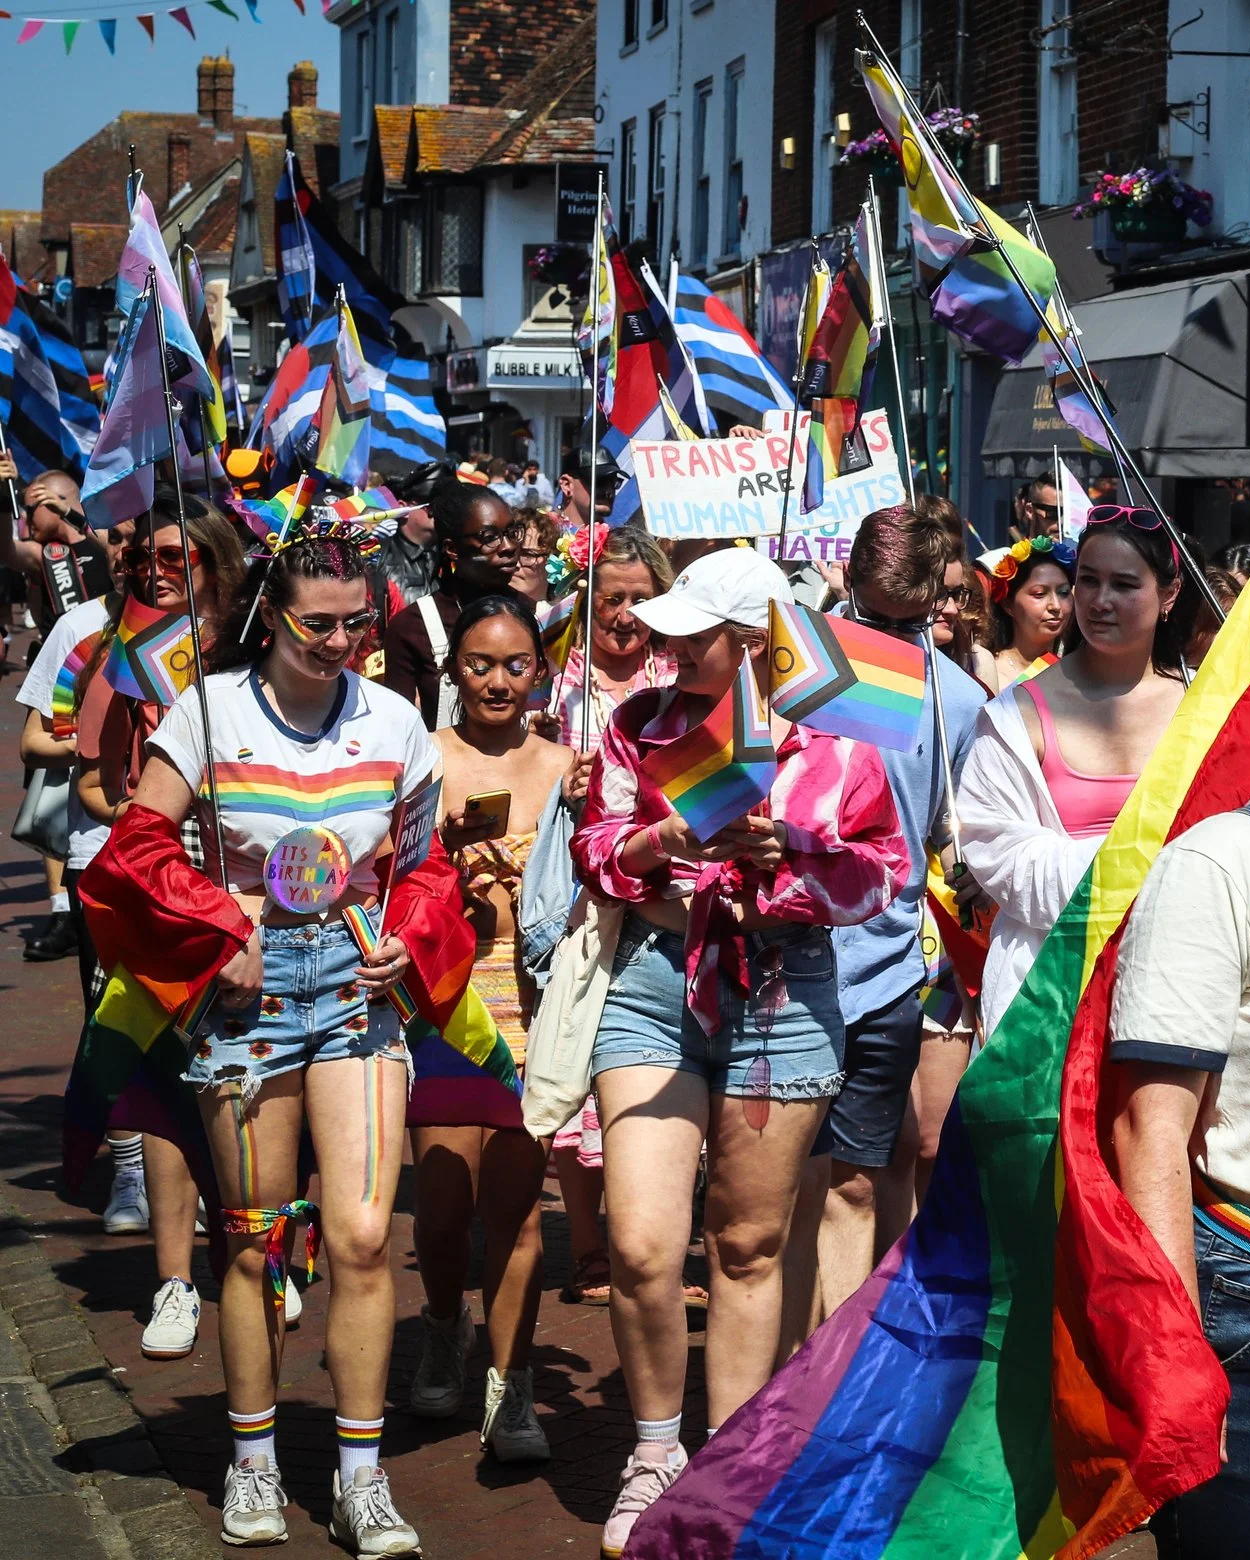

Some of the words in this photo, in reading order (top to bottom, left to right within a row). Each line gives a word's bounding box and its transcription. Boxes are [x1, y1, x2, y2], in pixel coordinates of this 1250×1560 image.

[568, 204, 595, 214] Hotel
[494, 362, 541, 377] BUBBLE
[545, 362, 572, 377] MILK
[635, 441, 757, 479] TRANS
[737, 468, 796, 499] ARE
[646, 500, 766, 537] HUMAN
[768, 534, 853, 561] HATE
[51, 560, 73, 592] MR
[398, 808, 436, 855] PRIDE
[288, 885, 323, 904] YAY
